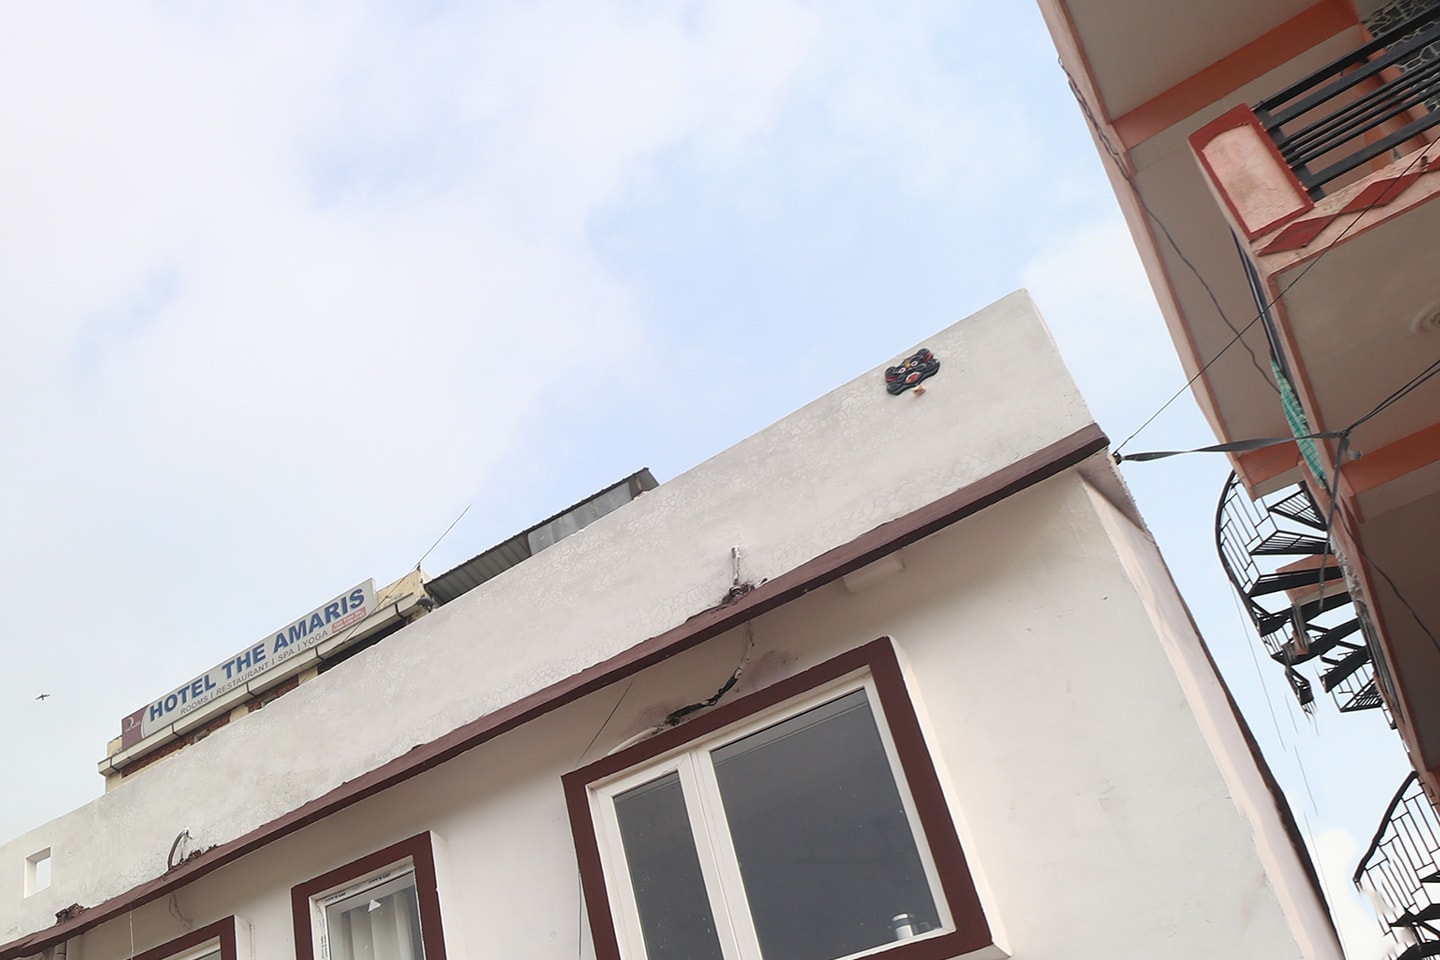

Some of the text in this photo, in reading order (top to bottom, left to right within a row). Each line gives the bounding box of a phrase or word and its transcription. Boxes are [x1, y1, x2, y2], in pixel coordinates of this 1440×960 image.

[150, 674, 216, 722] HOTEL
[222, 643, 266, 679] THE
[273, 588, 365, 654] AMARIS
[180, 630, 328, 716] ROOMS RESTAURANT SPA YOGA
